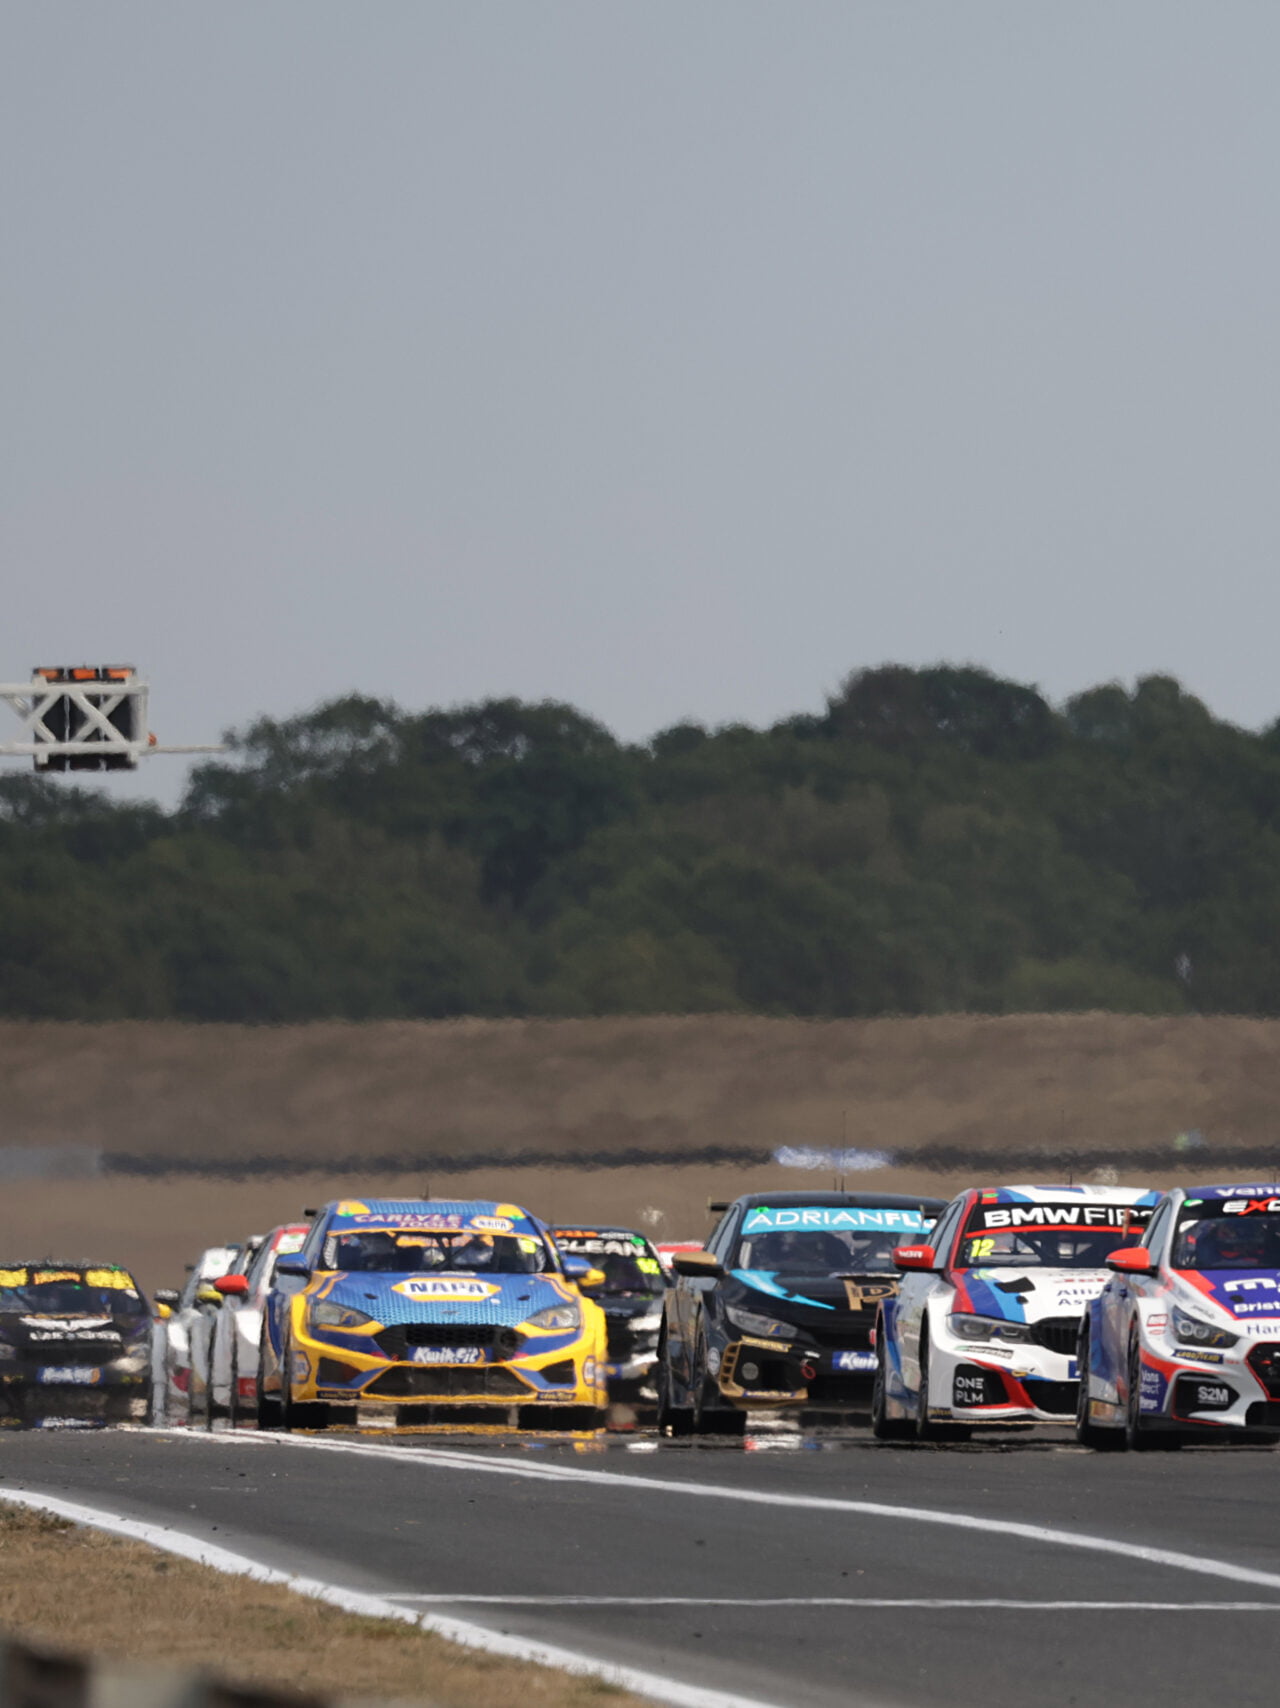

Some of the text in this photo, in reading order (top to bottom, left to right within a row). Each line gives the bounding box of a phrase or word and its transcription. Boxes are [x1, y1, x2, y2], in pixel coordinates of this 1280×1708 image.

[748, 1211, 938, 1229] ADRIANFLU
[971, 1239, 995, 1258] 12
[410, 1282, 485, 1294] NAPA
[955, 1376, 985, 1390] ONE
[955, 1391, 984, 1404] PLM
[1198, 1385, 1229, 1402] S2M
